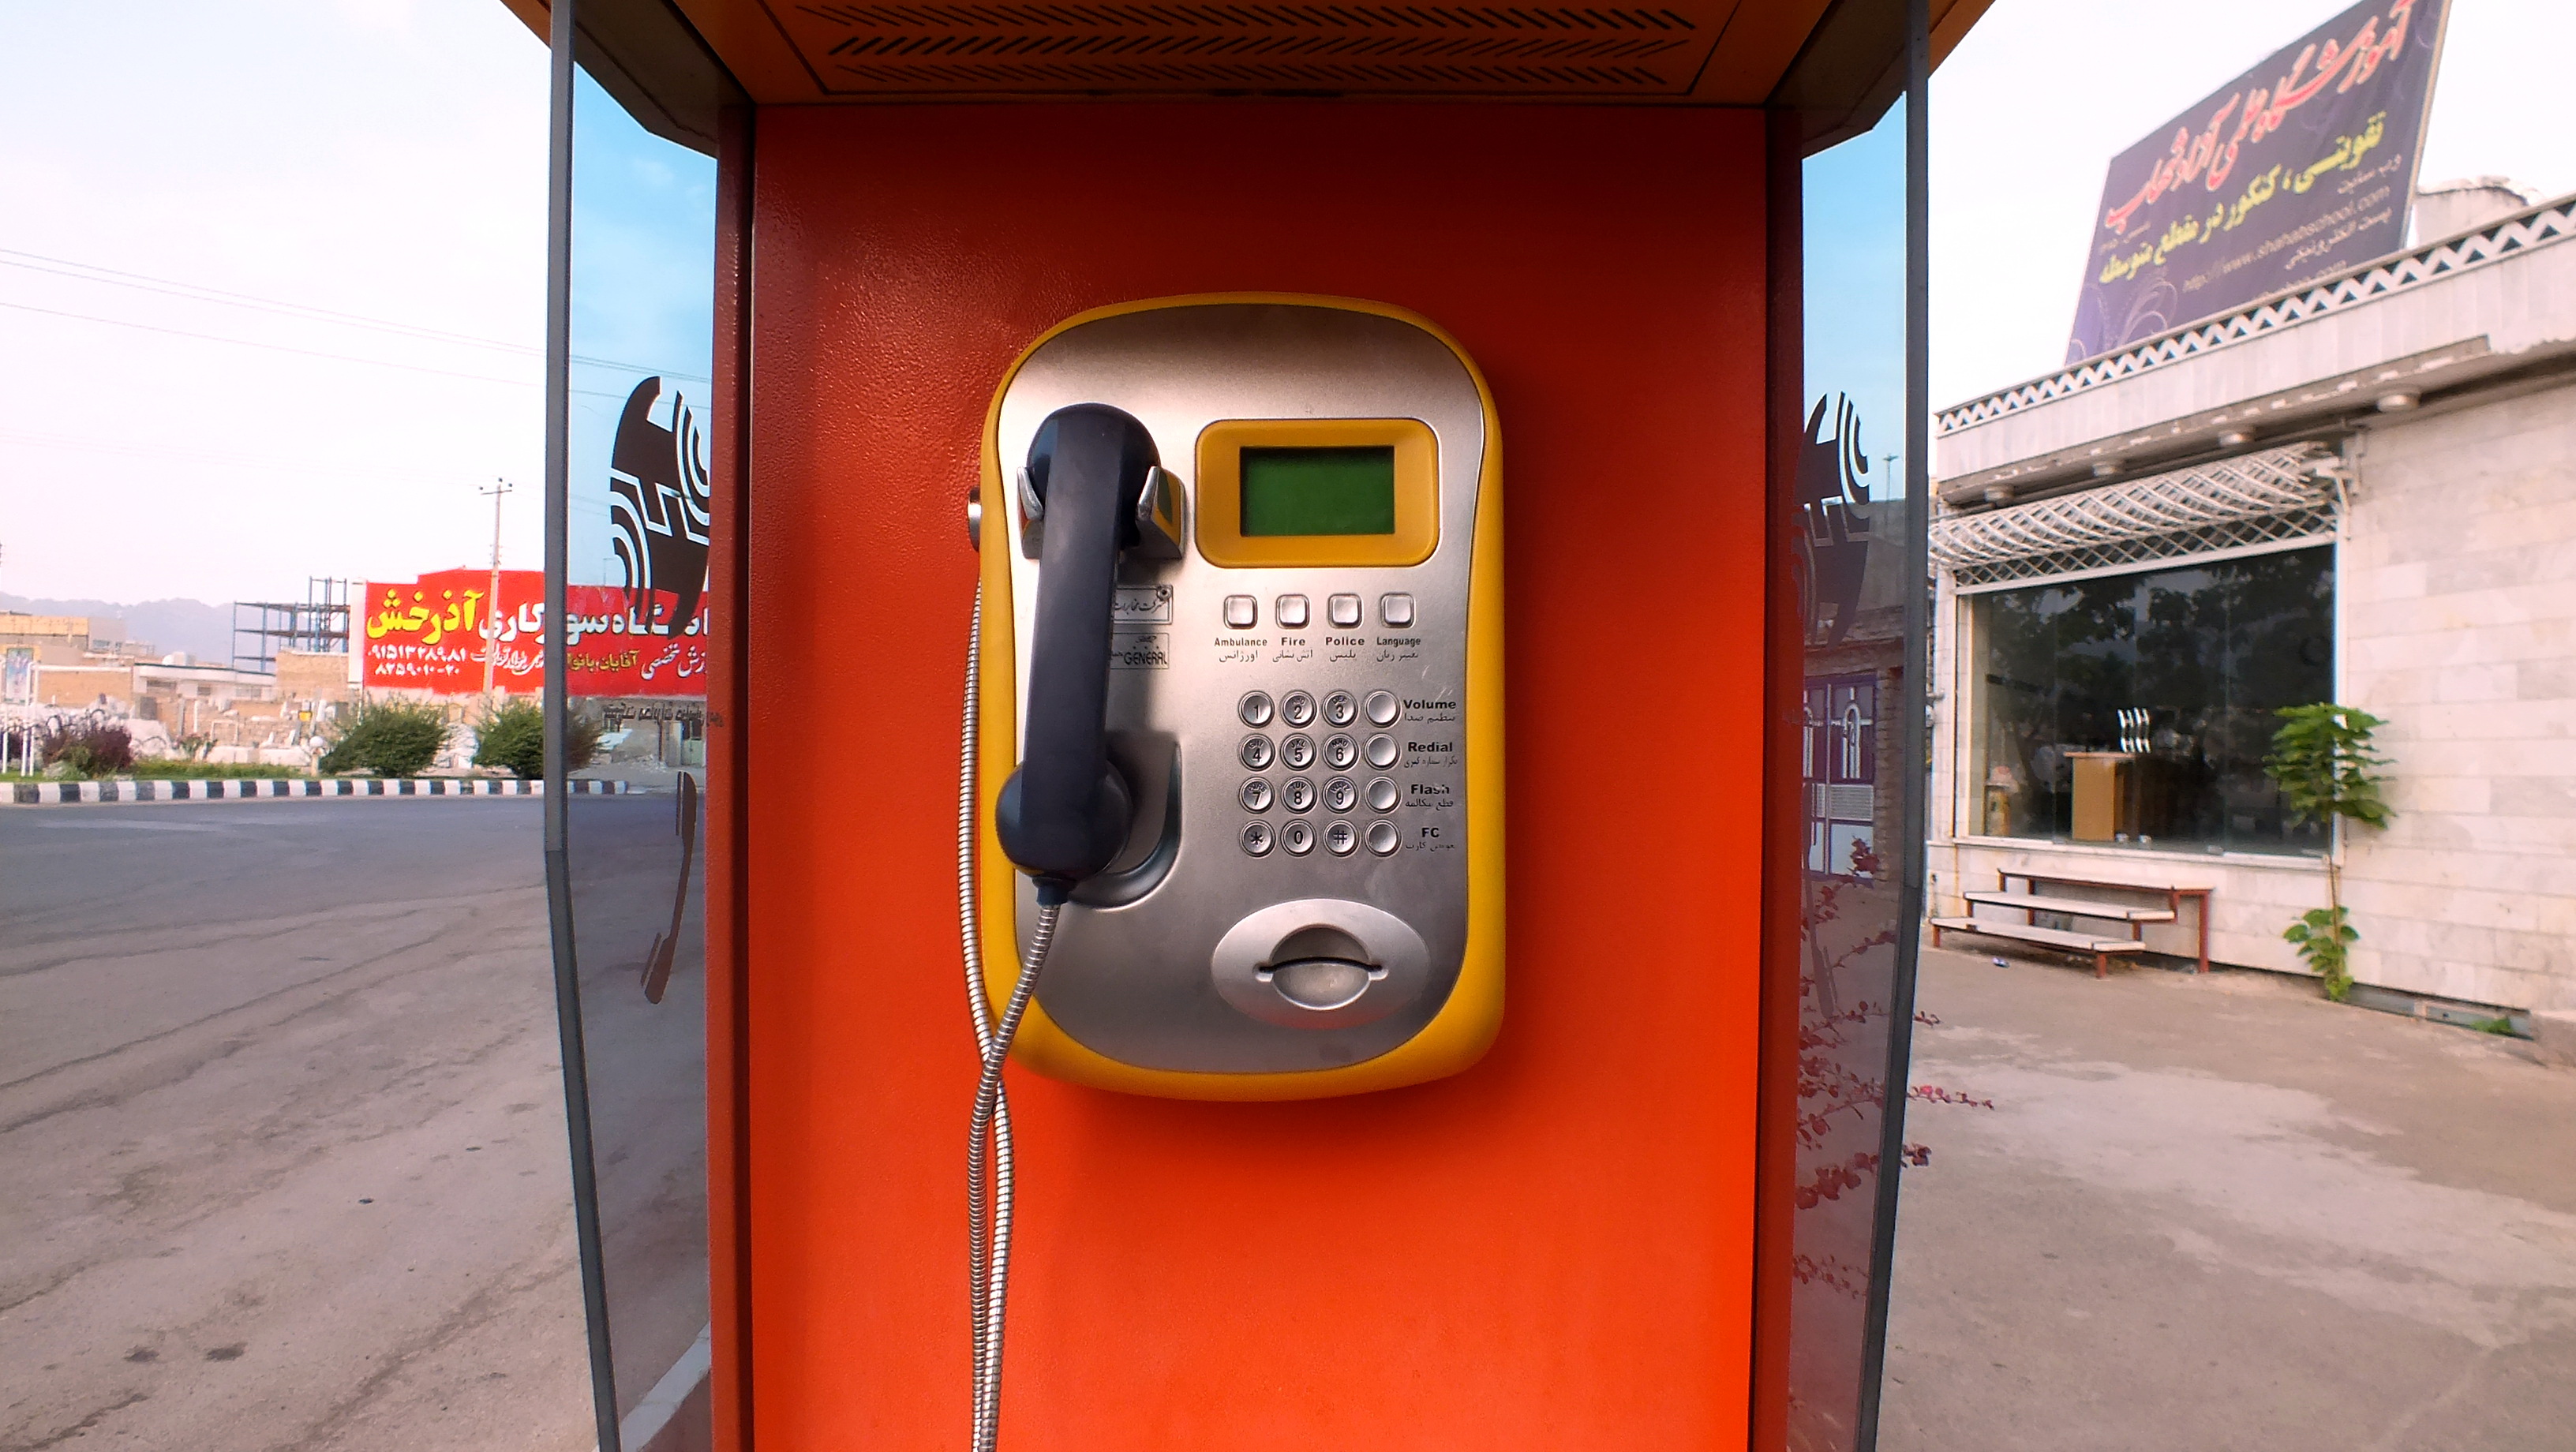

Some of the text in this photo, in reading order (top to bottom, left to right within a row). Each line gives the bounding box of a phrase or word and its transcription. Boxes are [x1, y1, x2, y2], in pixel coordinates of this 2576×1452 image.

[366, 589, 485, 645] آذرخش
[1214, 637, 1267, 647] Ambulance
[1281, 637, 1306, 646] Fire
[1325, 637, 1365, 646] Police
[1376, 637, 1421, 648] Language
[1123, 651, 1169, 666] GENERAL
[1403, 699, 1457, 709] Volume
[1253, 704, 1260, 720] 1
[1293, 705, 1303, 720] 2
[1335, 704, 1345, 720] 3
[1294, 747, 1304, 762] 5
[1335, 747, 1345, 762] 6
[1408, 742, 1453, 752] Redial
[1252, 747, 1263, 763] 4
[1252, 791, 1261, 806] 7
[1293, 791, 1304, 806] 8
[1335, 791, 1345, 806] 9
[1294, 830, 1304, 845] 0
[1421, 827, 1440, 838] FC
